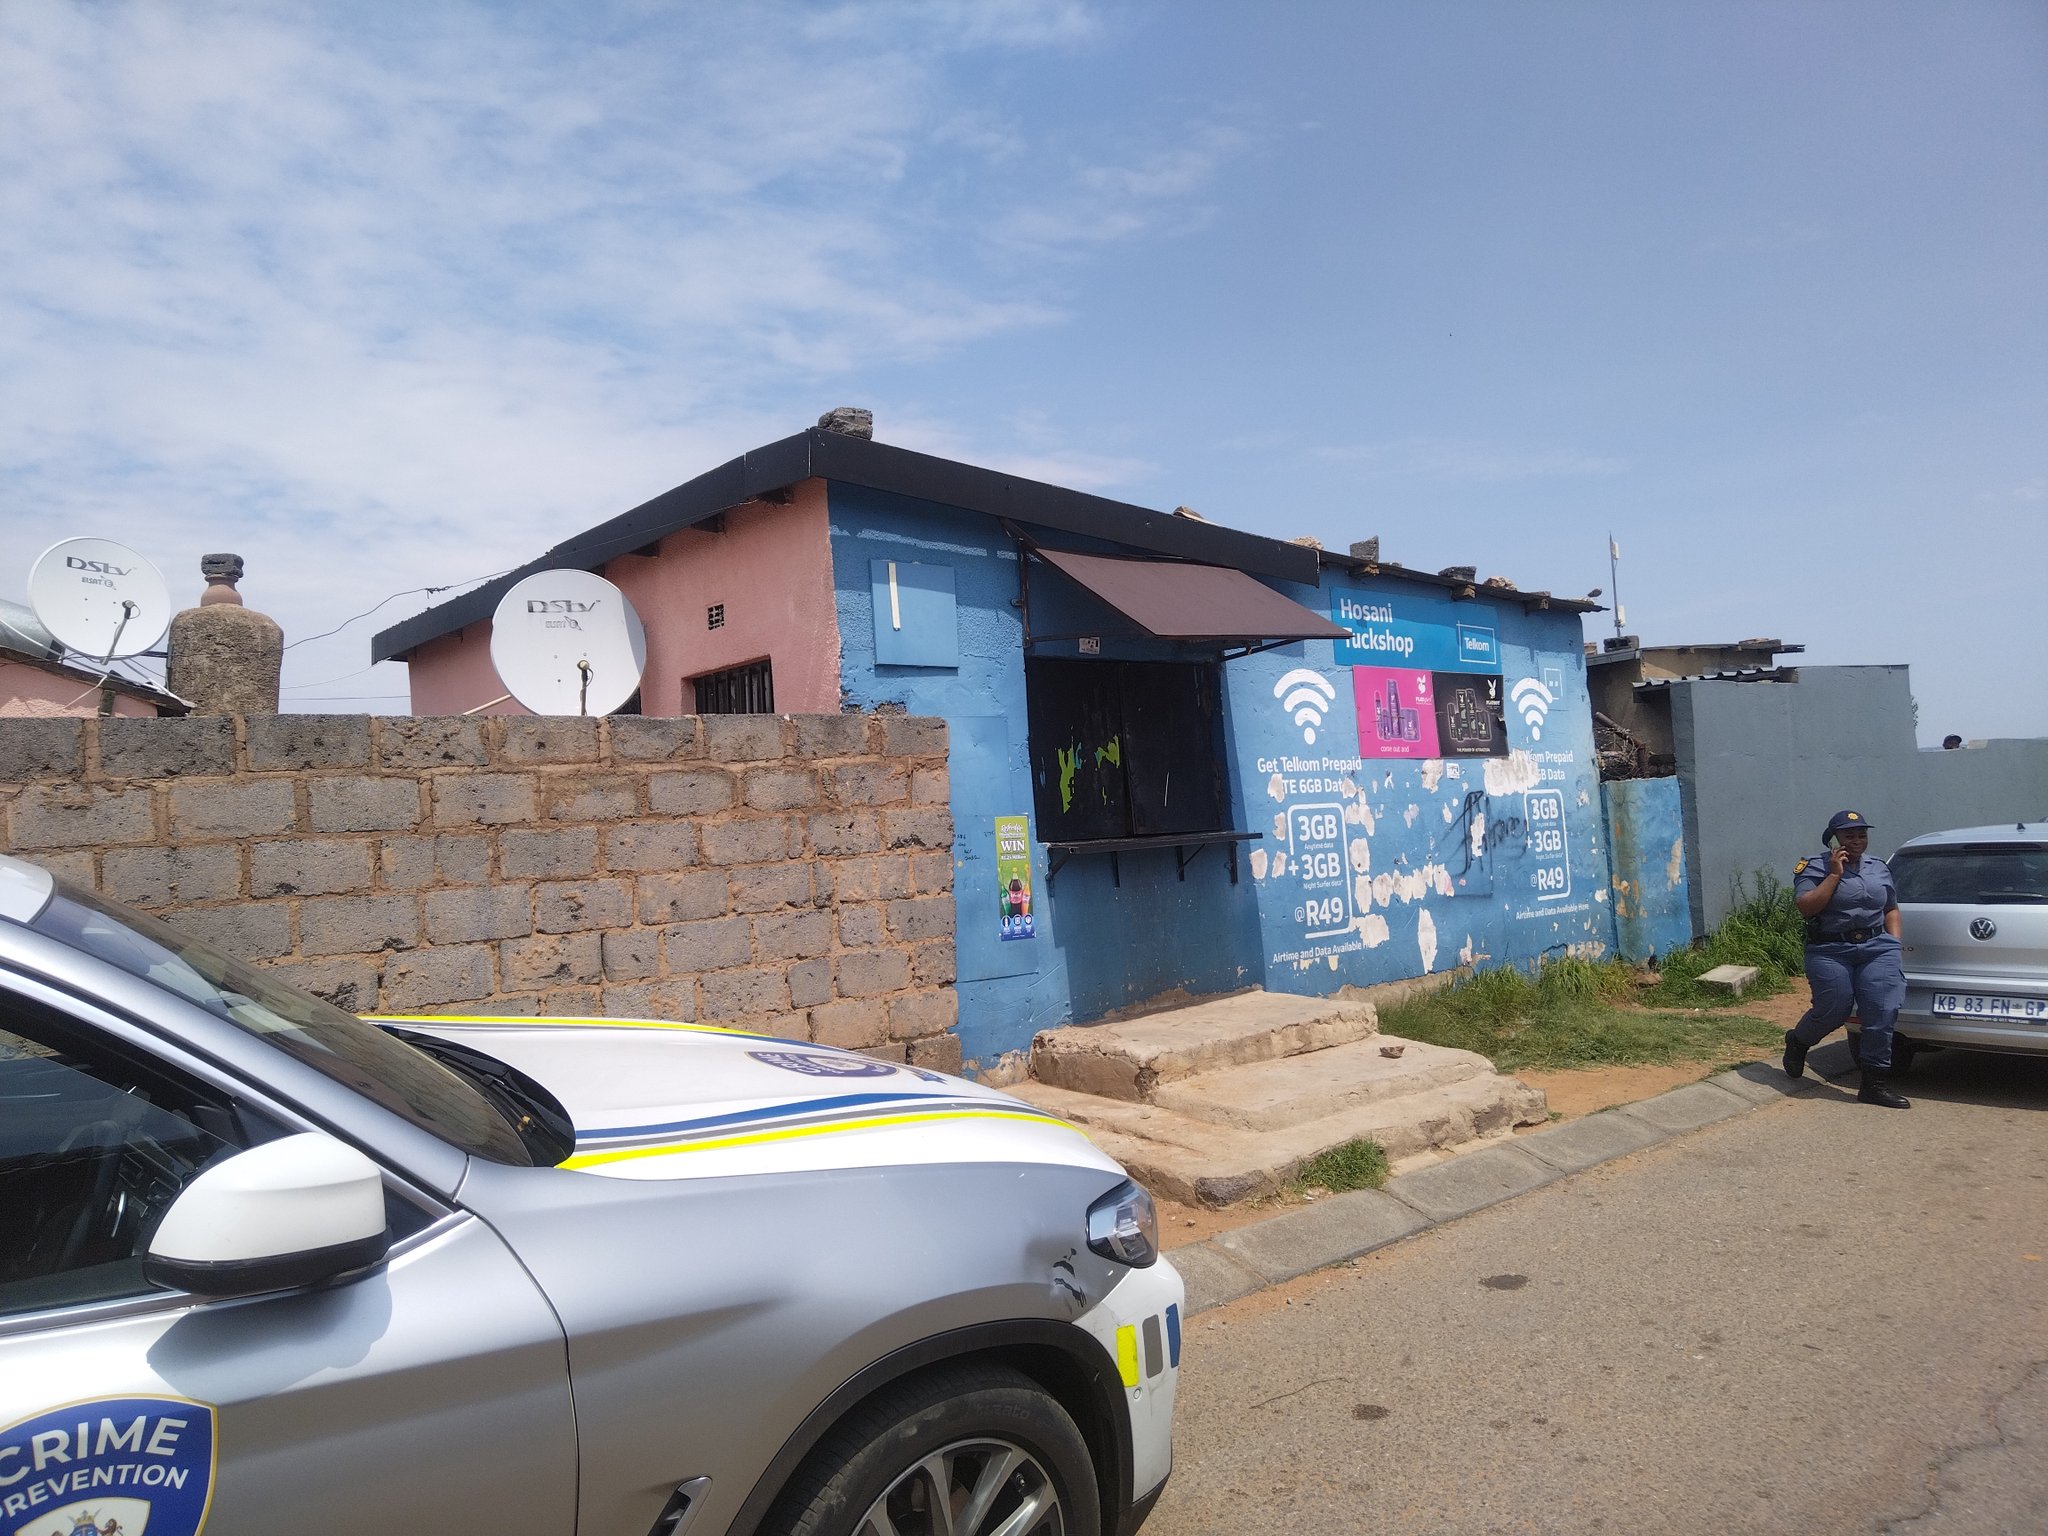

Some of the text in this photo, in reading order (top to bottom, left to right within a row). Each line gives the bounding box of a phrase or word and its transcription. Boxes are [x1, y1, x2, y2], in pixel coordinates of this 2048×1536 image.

[1340, 598, 1393, 623] Hosani
[1464, 637, 1490, 652] Telkom
[1257, 756, 1362, 774] Get Telkom Prepaid
[1545, 750, 1573, 765] Prepaid
[1548, 769, 1565, 780] Data
[1282, 778, 1343, 794] TE 6GB Dat
[1531, 799, 1558, 820] 3GB
[1298, 814, 1337, 841] 3GB
[1000, 840, 1025, 851] WIN
[1534, 830, 1562, 852] 3GB
[1301, 852, 1341, 880] 3GB
[1273, 952, 1299, 963] Airtime
[1300, 947, 1314, 958] and
[1315, 946, 1331, 957] Data
[1332, 940, 1362, 954] Available
[1938, 995, 2046, 1016] KB 83 FN GP
[0, 1415, 188, 1487] CRIME
[0, 1463, 190, 1519] REVENTION
